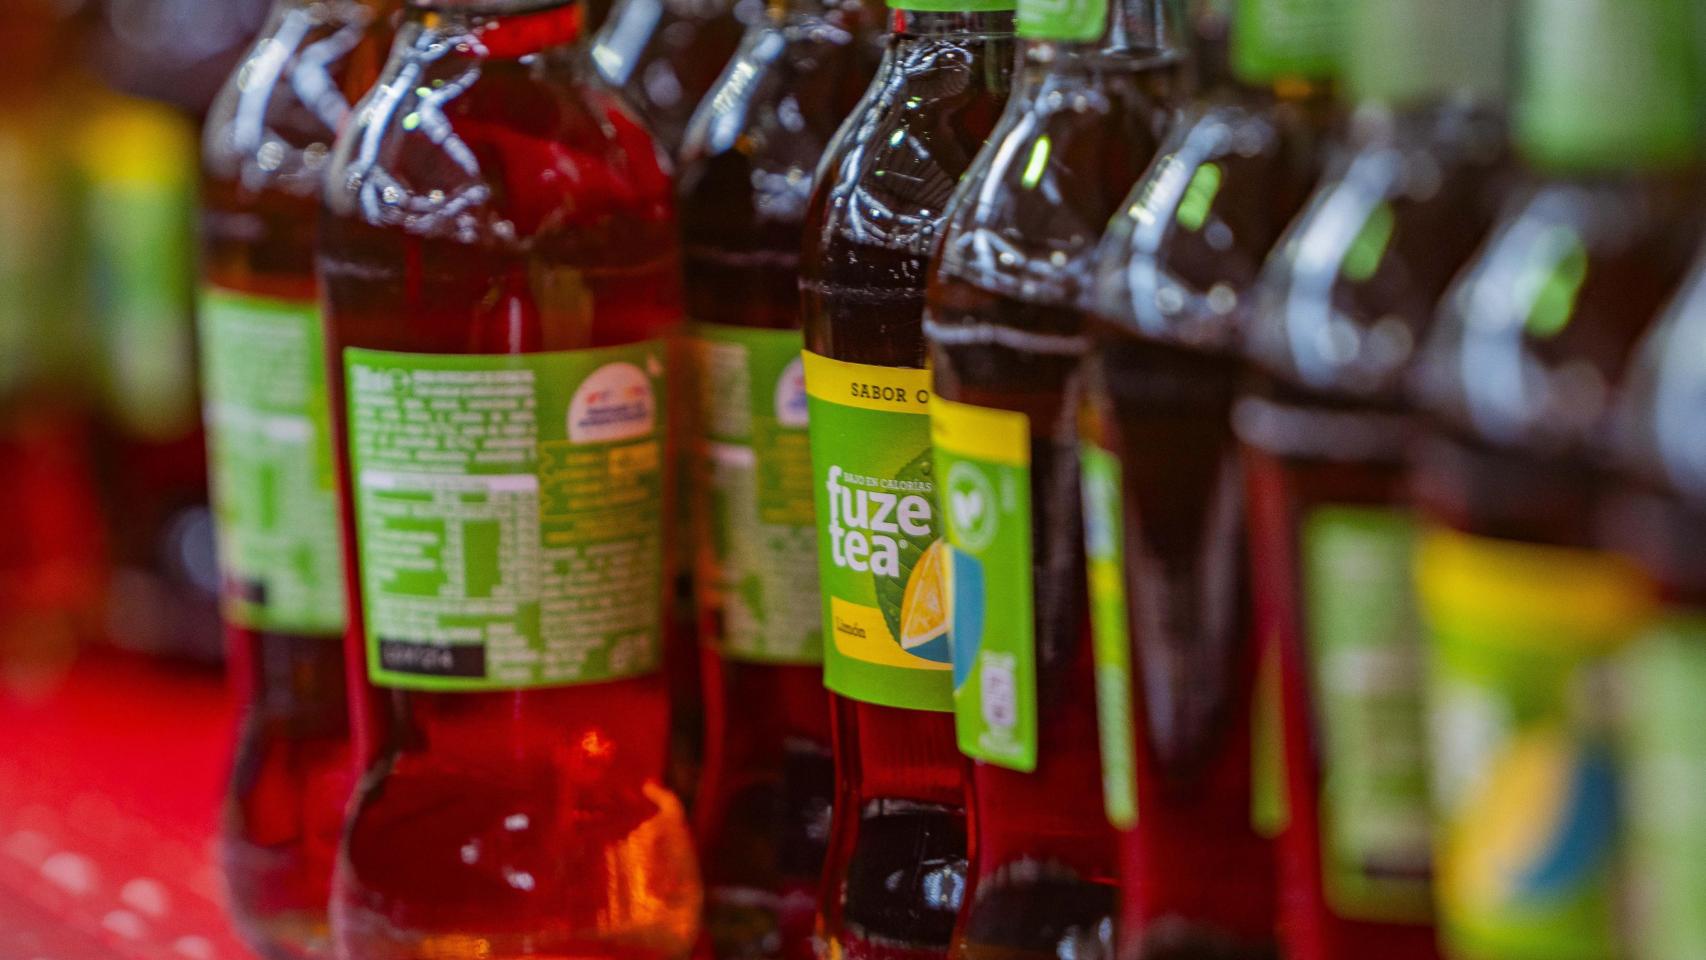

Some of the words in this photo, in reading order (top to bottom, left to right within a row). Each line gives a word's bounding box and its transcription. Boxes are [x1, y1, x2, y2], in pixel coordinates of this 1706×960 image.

[851, 382, 907, 402] SABOR
[843, 472, 865, 486] BAJO
[865, 476, 879, 487] EN
[827, 465, 931, 536] fuze
[830, 523, 899, 577] tea
[836, 616, 867, 639] Limón
